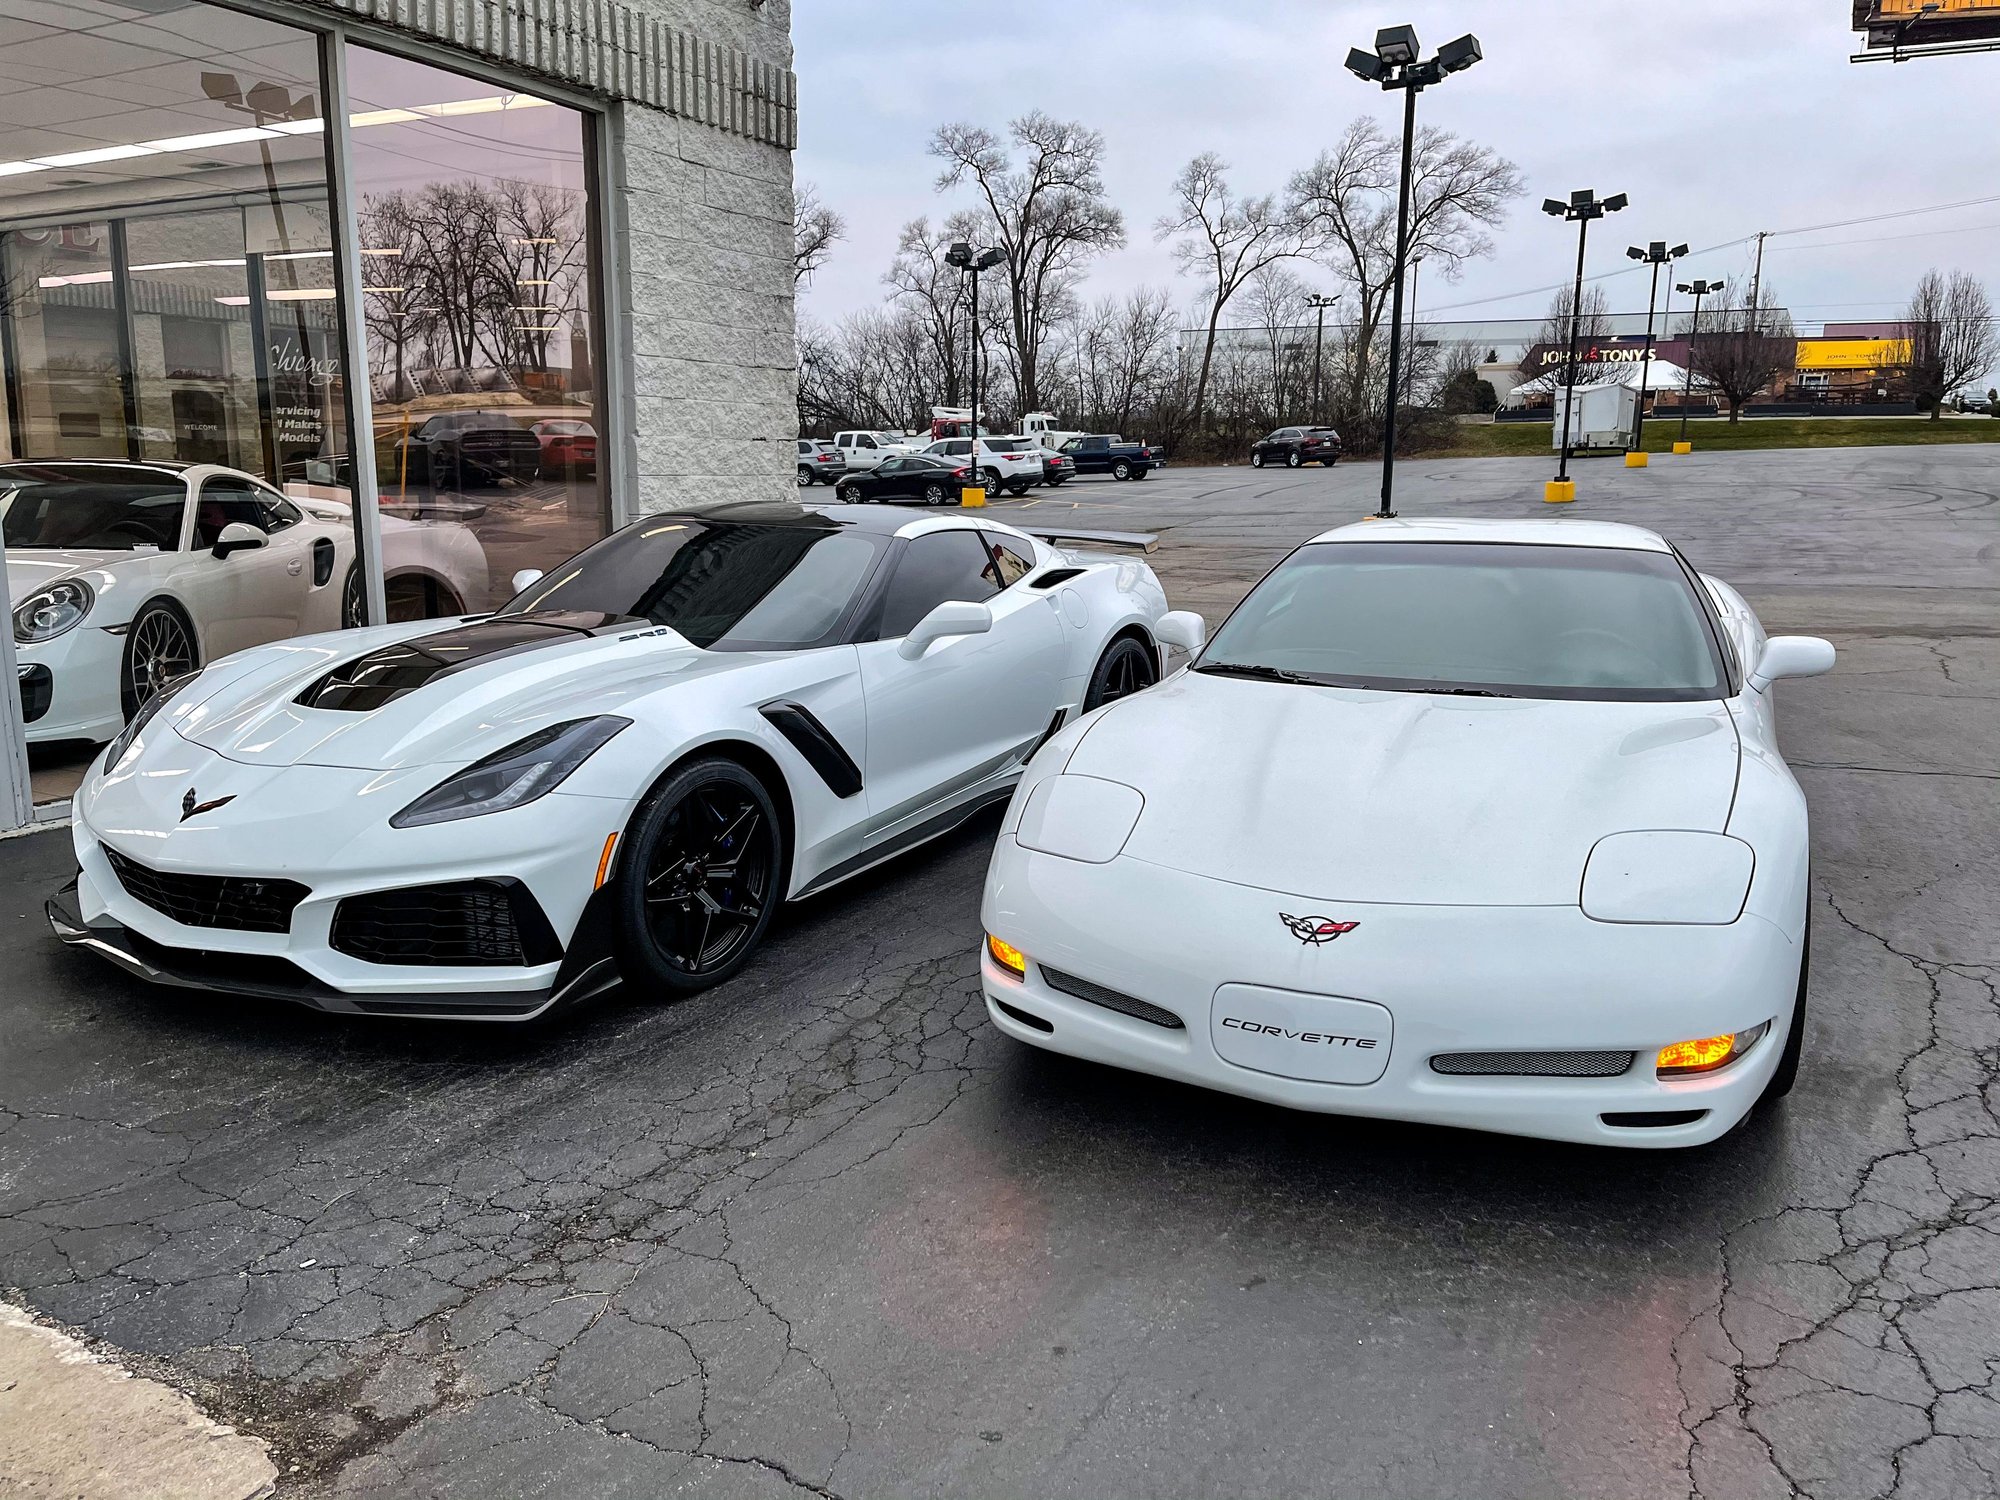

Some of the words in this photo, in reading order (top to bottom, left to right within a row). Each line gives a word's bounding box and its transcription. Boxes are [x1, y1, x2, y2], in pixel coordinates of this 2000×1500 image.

[276, 406, 321, 418] ervicing
[183, 423, 218, 431] WELCOME
[284, 420, 322, 430] Makes
[279, 433, 321, 443] Models
[1222, 1017, 1378, 1049] CORVETTE
